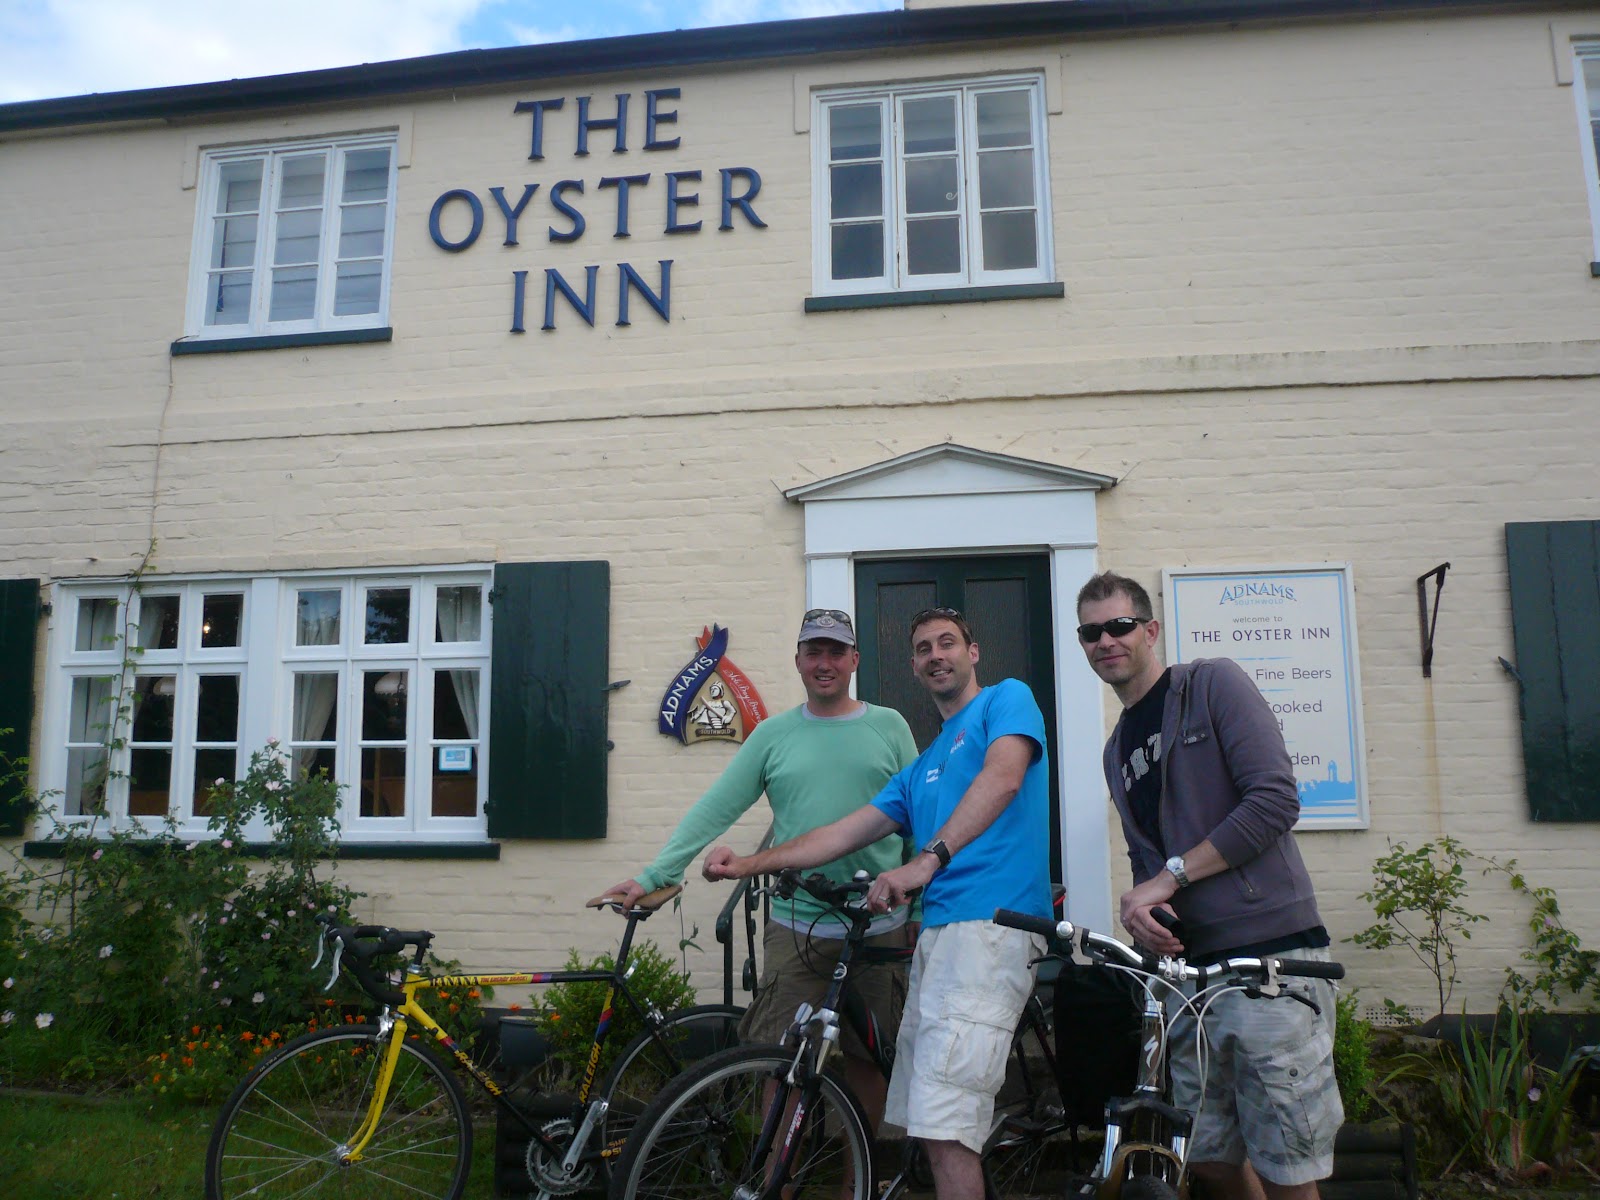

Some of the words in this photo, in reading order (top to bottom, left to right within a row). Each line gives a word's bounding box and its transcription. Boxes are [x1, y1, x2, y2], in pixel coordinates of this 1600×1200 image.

[513, 87, 682, 161] THE
[428, 166, 769, 253] OYSTER
[509, 259, 675, 333] INN
[1234, 598, 1284, 606] SOUTHWOLD
[1232, 615, 1270, 624] welcome
[1273, 615, 1283, 623] to
[1191, 630, 1222, 643] THE
[1232, 628, 1293, 642] OYSTER
[1301, 627, 1331, 640] INN
[1256, 668, 1285, 680] Fine
[1291, 667, 1332, 680] Beers
[1265, 699, 1323, 714] ooked
[1290, 752, 1321, 766] den
[579, 1041, 602, 1104] RALEIGH
